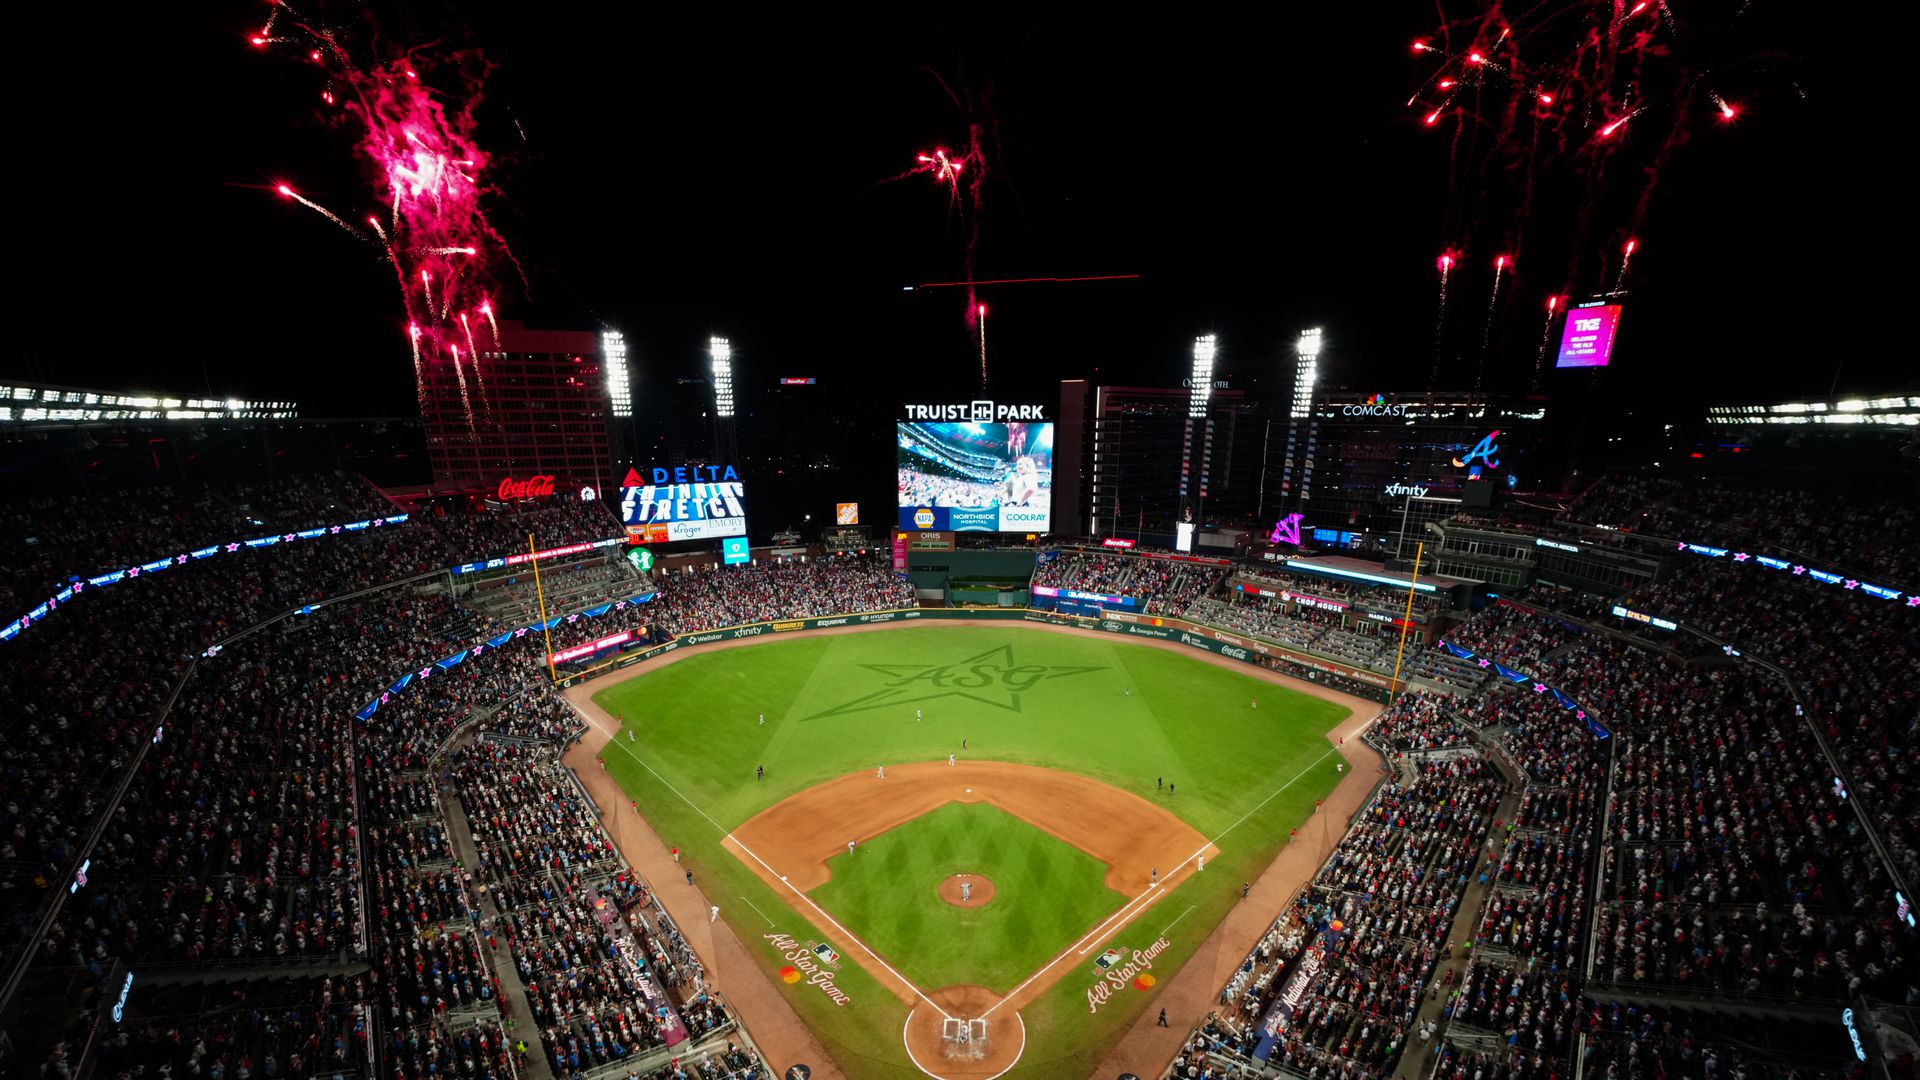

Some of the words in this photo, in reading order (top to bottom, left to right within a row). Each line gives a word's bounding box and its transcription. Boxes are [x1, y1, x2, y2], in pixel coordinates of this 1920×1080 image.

[905, 405, 968, 419] TRUIST
[997, 405, 1044, 419] PARK
[1342, 405, 1407, 417] COMCAST
[653, 465, 737, 483] DELTA
[498, 474, 555, 499] Coca-Cola
[1384, 483, 1429, 497] xfinity
[621, 497, 745, 522] STRETCH
[709, 518, 744, 528] EMORY
[917, 514, 933, 523] NAPA
[674, 523, 702, 538] Kroger
[1105, 539, 1132, 548] RaceTrac
[1260, 589, 1276, 598] LIGHT
[1296, 597, 1315, 607] CHOP
[1317, 602, 1343, 612] HOUSE
[773, 622, 805, 630] QUIKRETE
[817, 618, 847, 626] EQUIFAX
[697, 633, 722, 642] Wellstar
[734, 626, 762, 638] xfinity
[1137, 628, 1153, 636] Georgia
[1221, 645, 1247, 659] Coca-Cola
[563, 679, 571, 688] G
[884, 663, 1049, 691] ASG
[763, 933, 799, 951] All
[785, 948, 819, 975] Star
[806, 970, 850, 1006] Game
[1087, 981, 1113, 1014] All
[1105, 963, 1141, 990] Star
[1132, 937, 1171, 969] Game
[1282, 970, 1311, 1012] National
